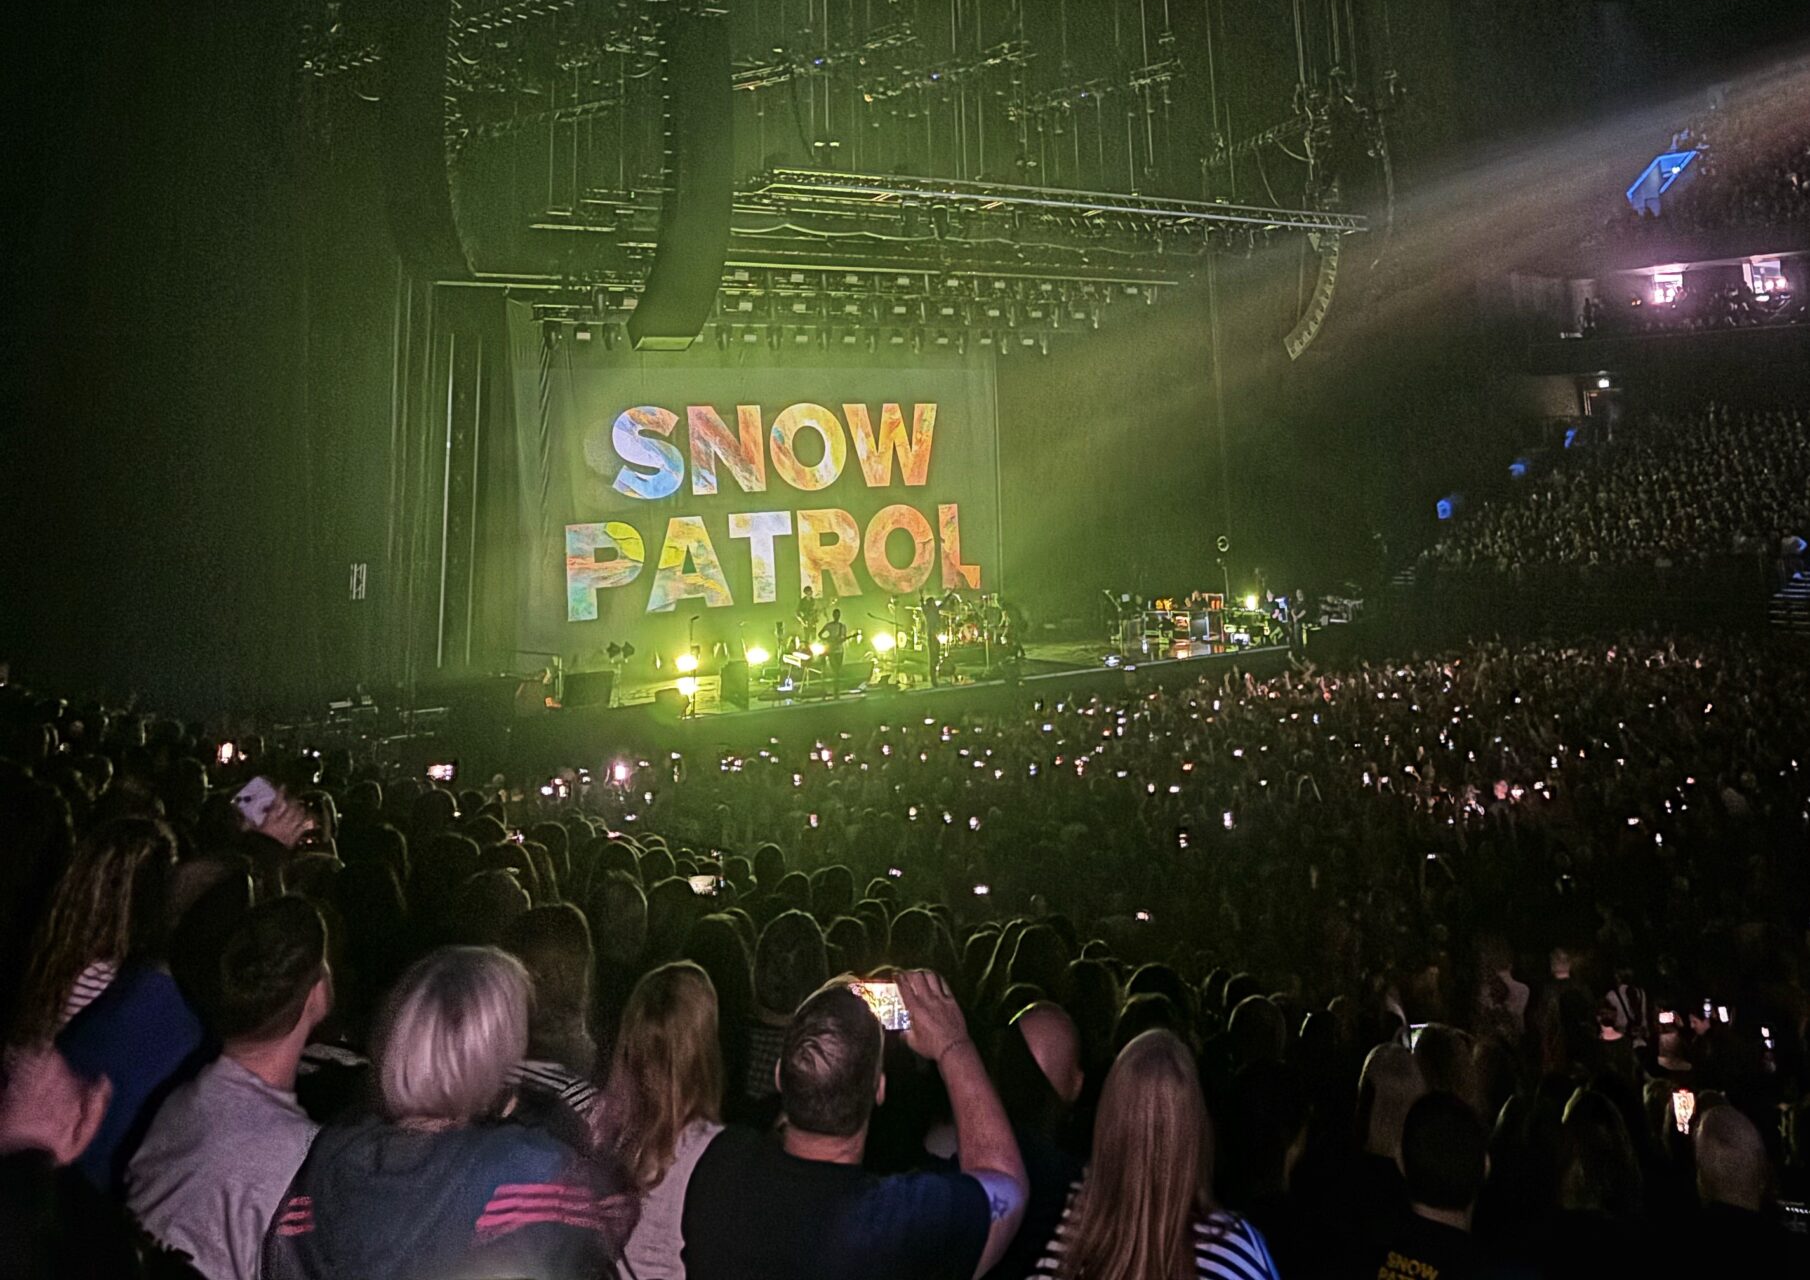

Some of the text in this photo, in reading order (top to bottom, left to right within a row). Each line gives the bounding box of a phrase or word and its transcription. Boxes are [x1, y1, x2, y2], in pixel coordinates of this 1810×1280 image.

[612, 402, 937, 499] SNOW
[565, 503, 981, 621] PATROL
[1386, 1250, 1440, 1280] SNOW
